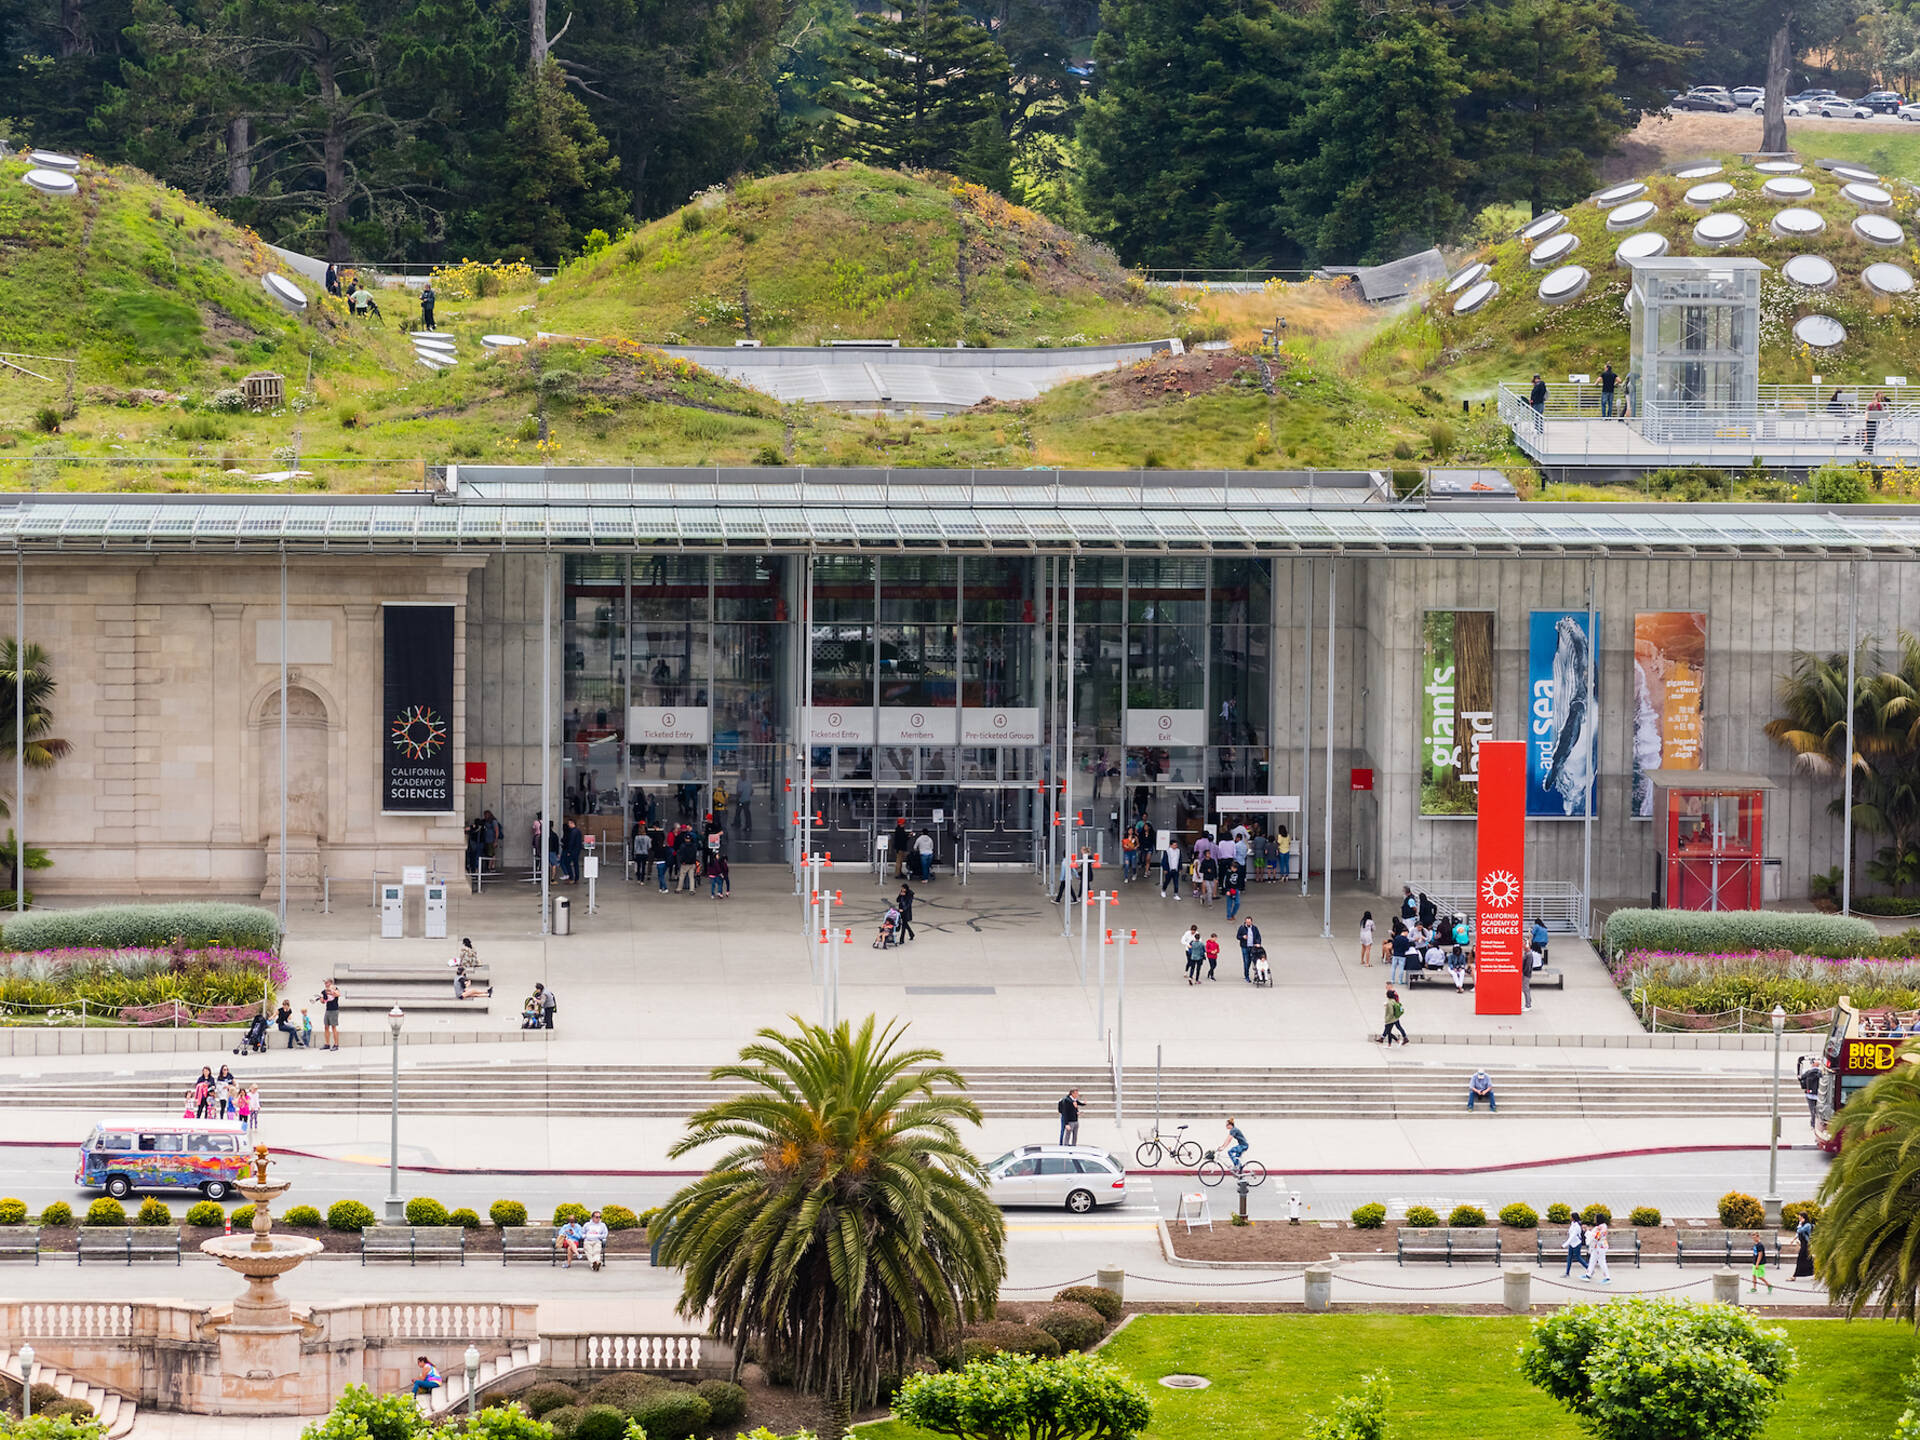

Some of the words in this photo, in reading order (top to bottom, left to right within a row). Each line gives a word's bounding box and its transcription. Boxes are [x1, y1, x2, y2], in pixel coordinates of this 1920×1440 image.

[1533, 680, 1553, 735] sea
[1425, 666, 1461, 768] giants
[644, 730, 674, 738] Ticketed
[675, 730, 694, 739] Entry
[811, 730, 840, 738] Ticketed
[841, 730, 860, 739] Entry
[900, 731, 934, 739] Members
[966, 731, 1008, 739] Pre-ticketed
[1009, 731, 1035, 740] Groups
[1159, 733, 1171, 741] Exit
[1536, 741, 1553, 770] and
[391, 768, 446, 776] CALIFORNIA
[391, 778, 433, 786] ACADEMY
[434, 778, 446, 786] OF
[391, 788, 446, 799] SCIENCES
[1849, 1042, 1875, 1057] BIG
[1848, 1057, 1875, 1069] BUS
